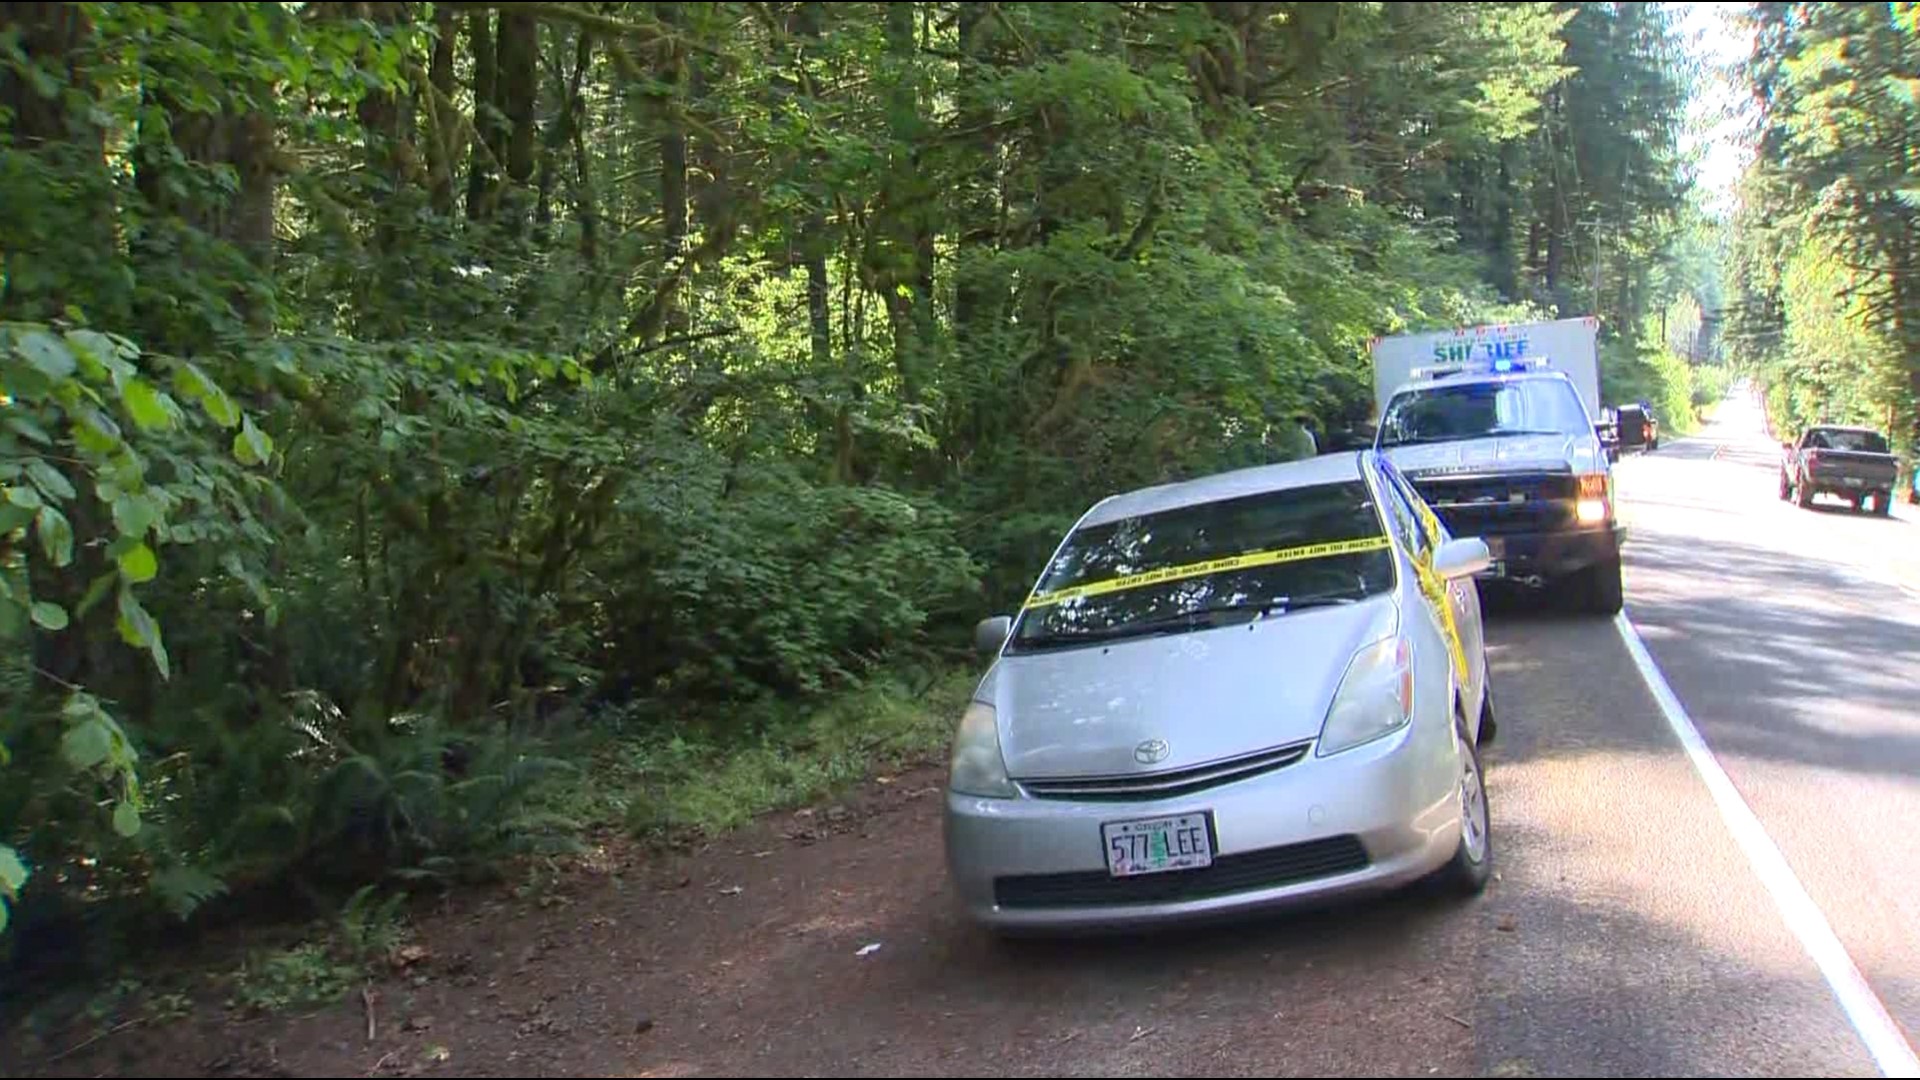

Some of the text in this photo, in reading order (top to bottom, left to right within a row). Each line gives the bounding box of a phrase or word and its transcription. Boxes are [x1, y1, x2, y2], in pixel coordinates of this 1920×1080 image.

[1276, 548, 1305, 558] ENTER
[1112, 827, 1204, 863] 577 LEE
